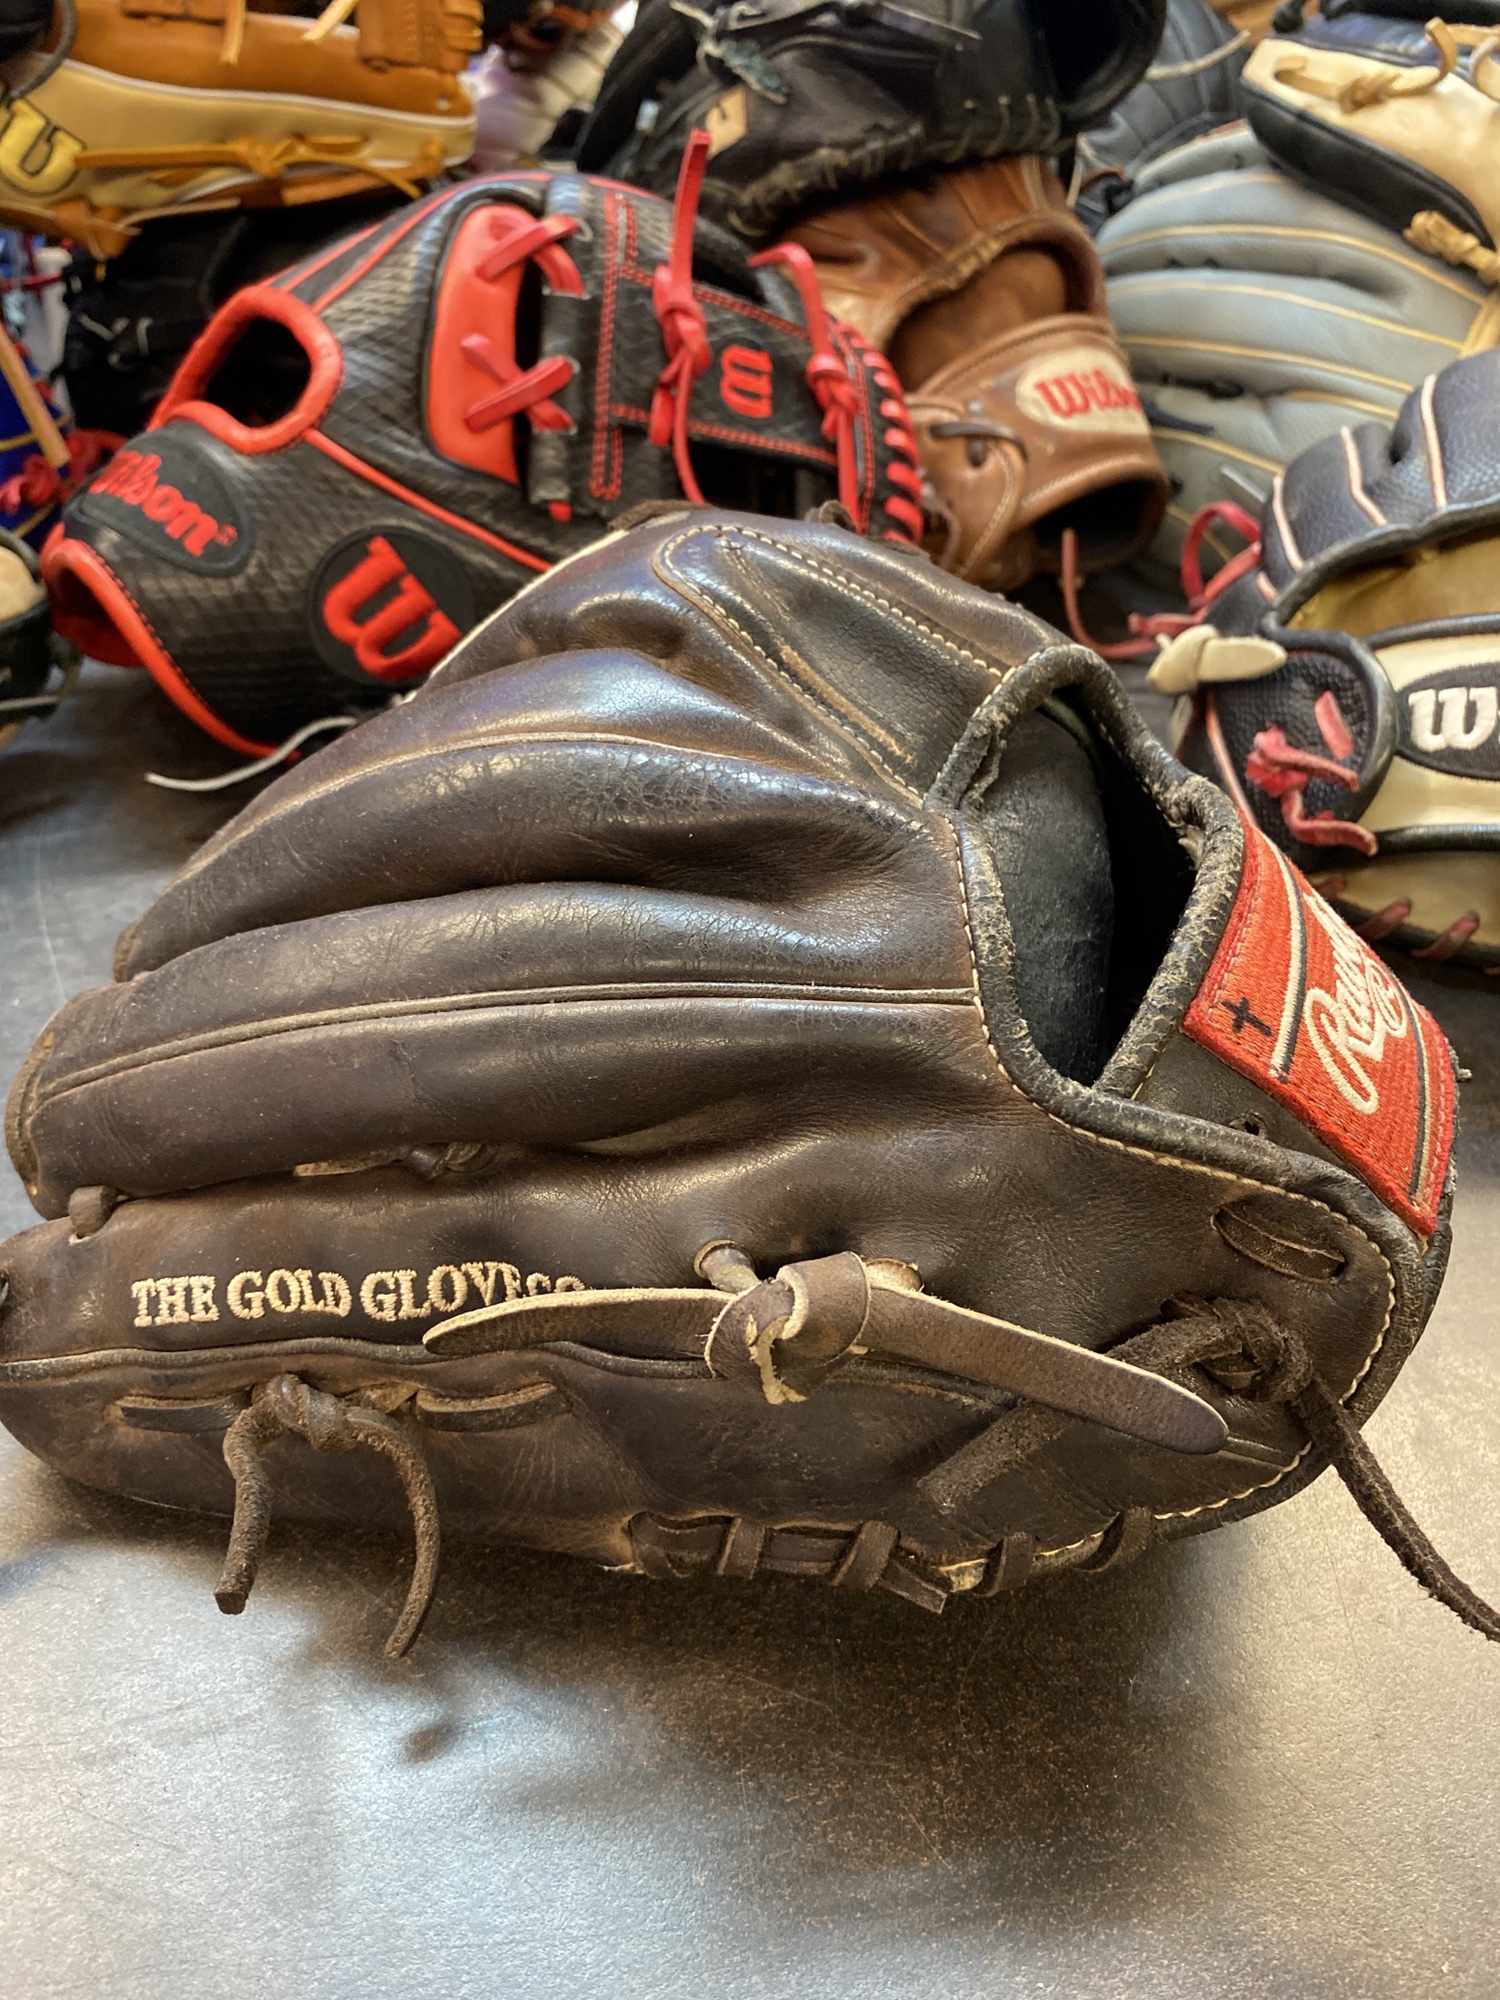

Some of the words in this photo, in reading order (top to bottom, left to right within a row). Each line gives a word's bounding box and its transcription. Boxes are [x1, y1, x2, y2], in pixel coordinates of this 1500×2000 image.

[131, 1275, 220, 1328] THE
[226, 1268, 352, 1320] GOLD
[359, 1261, 522, 1322] GLOVE
